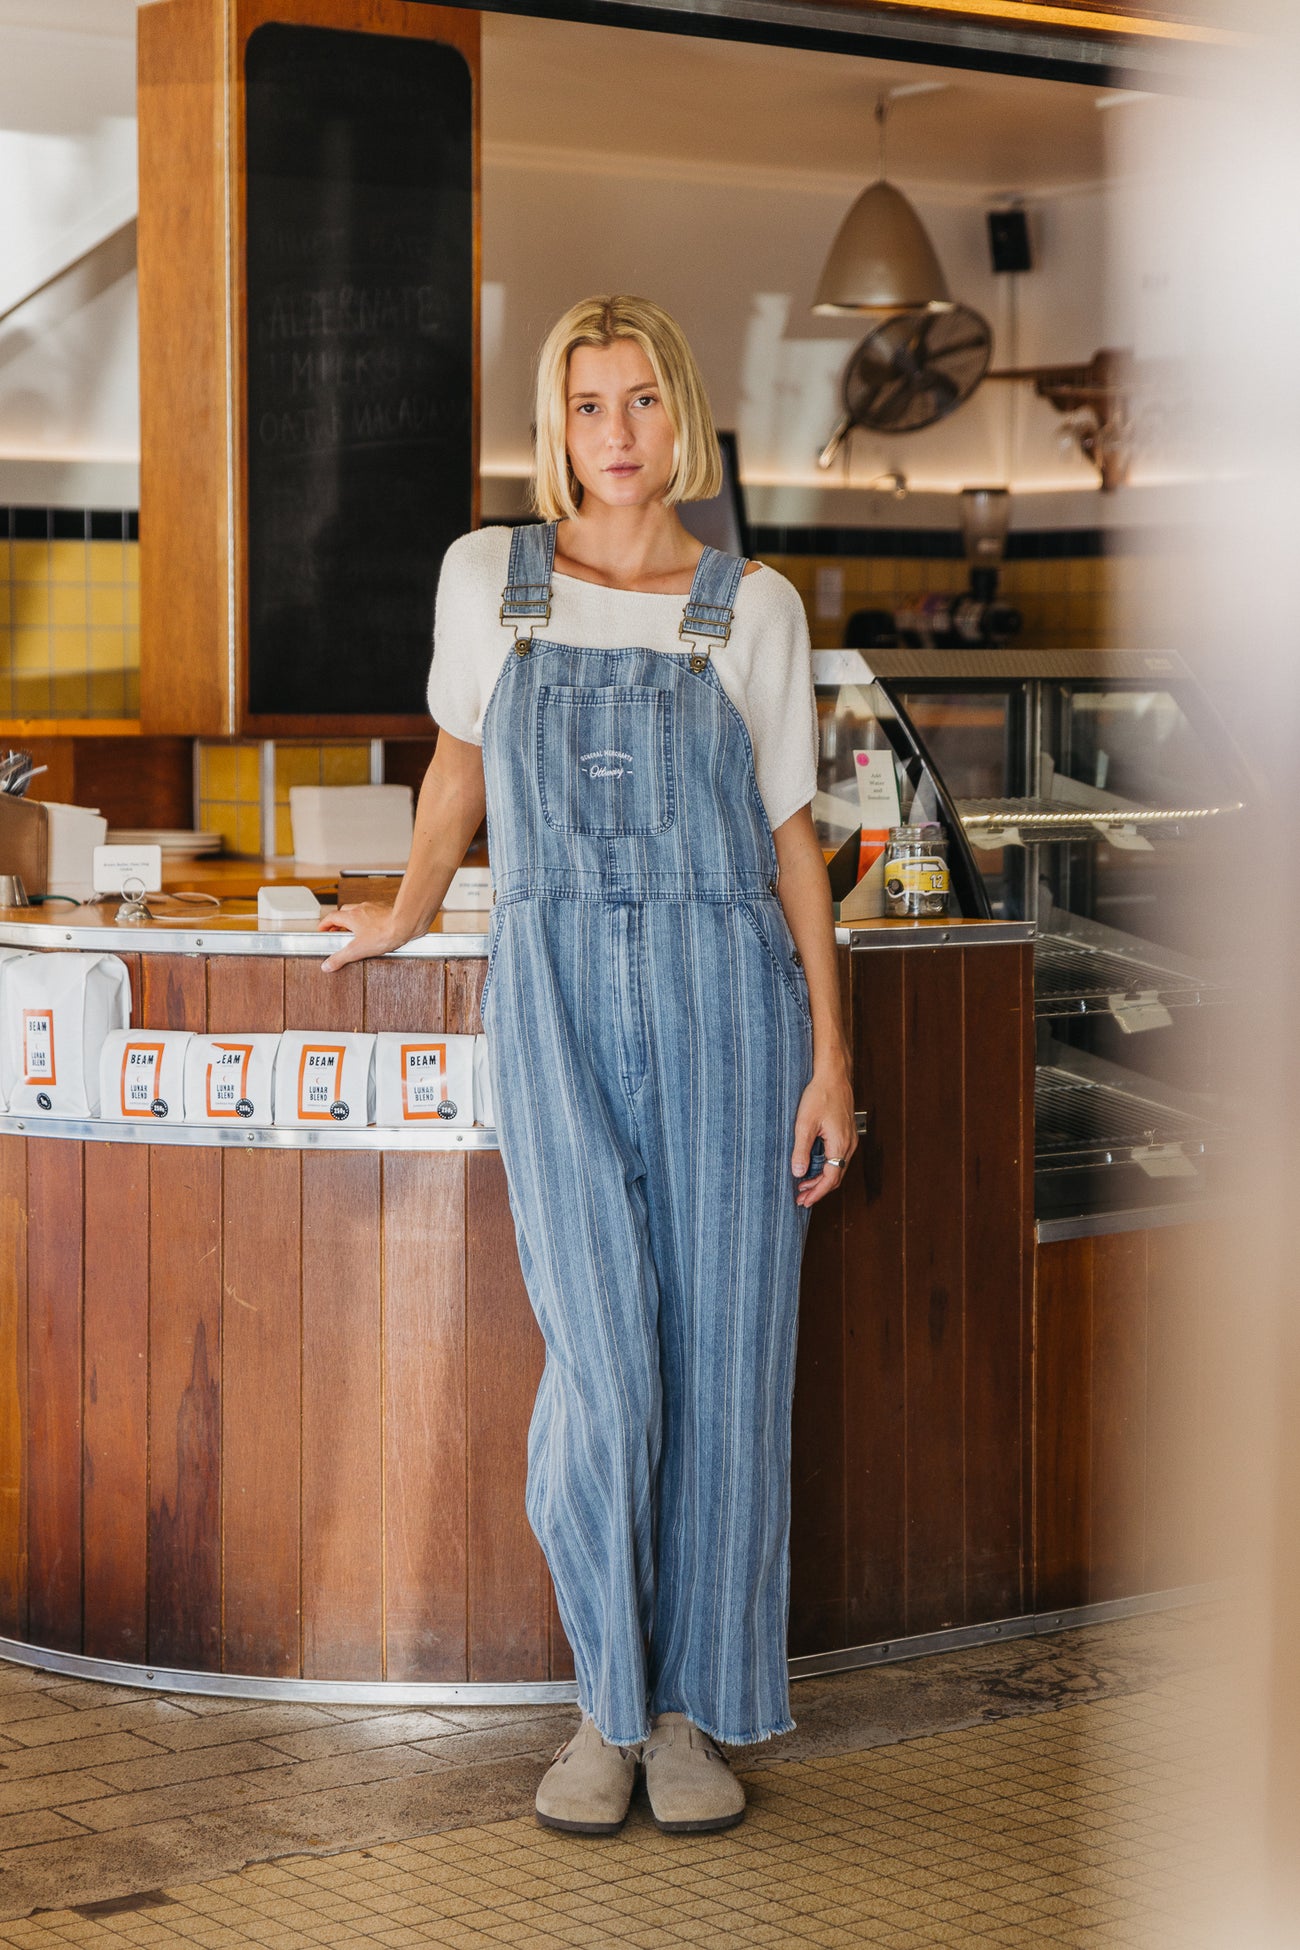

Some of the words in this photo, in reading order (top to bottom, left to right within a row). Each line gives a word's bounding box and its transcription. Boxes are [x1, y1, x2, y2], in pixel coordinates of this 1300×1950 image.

[930, 873, 943, 888] 12
[29, 1020, 47, 1032] BEAM
[130, 1054, 154, 1065] BEAM
[216, 1054, 241, 1064] EAM
[309, 1056, 334, 1066] BEAM
[410, 1055, 437, 1066] BEAM
[130, 1084, 148, 1092] LUNAR
[216, 1084, 235, 1092] LUNAR
[309, 1086, 328, 1094] LUNAR
[414, 1086, 434, 1094] LUNAR
